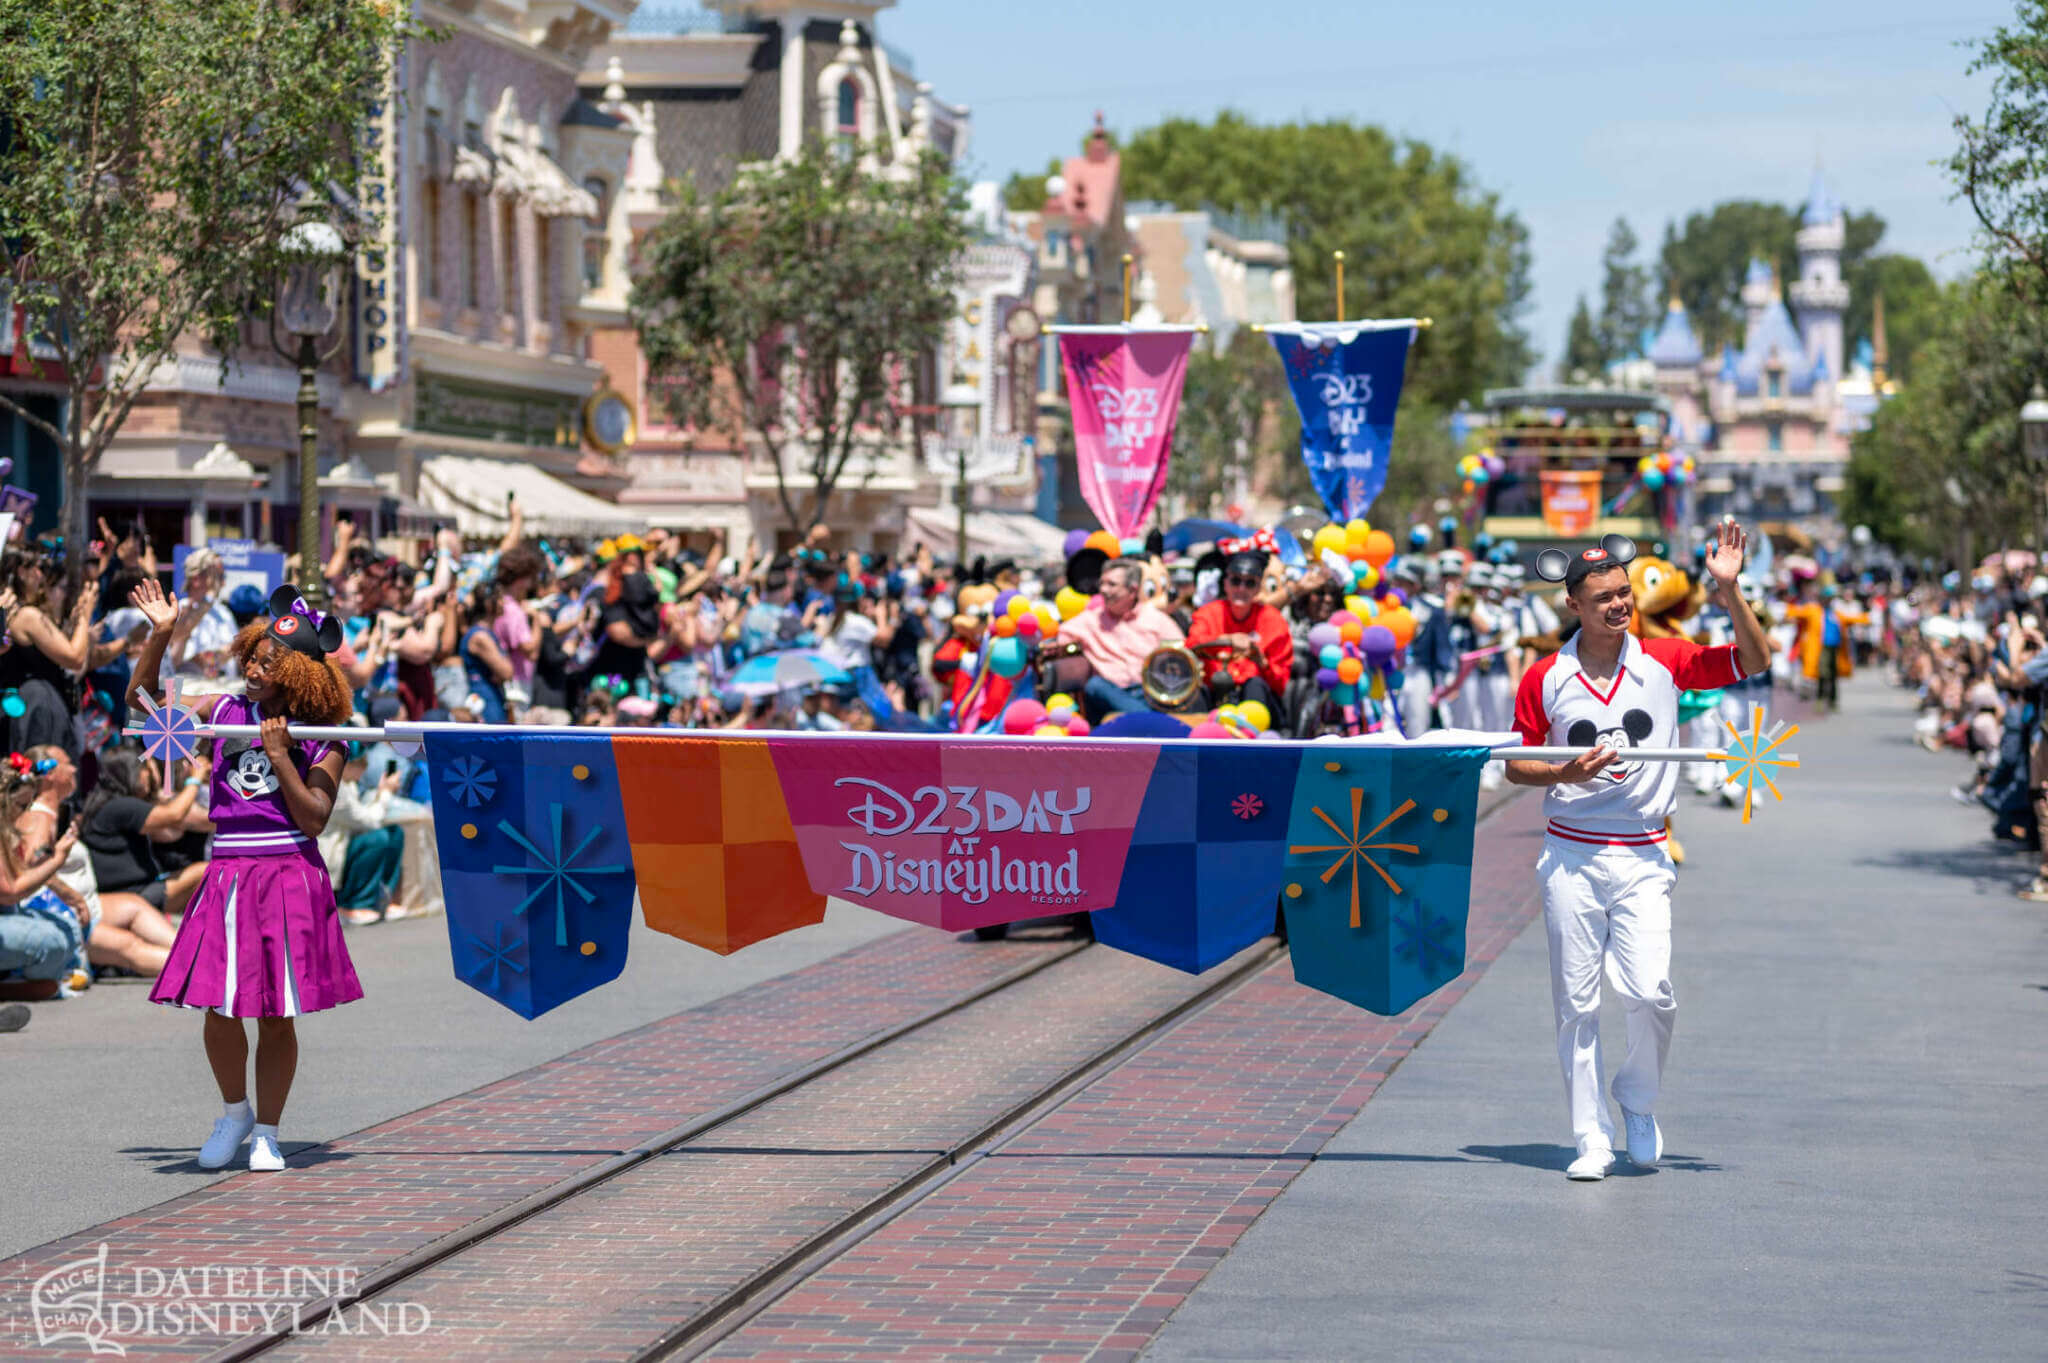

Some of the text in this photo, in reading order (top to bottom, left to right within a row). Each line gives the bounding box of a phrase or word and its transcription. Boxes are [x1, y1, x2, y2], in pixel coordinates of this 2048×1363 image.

[1092, 384, 1159, 418] D23
[1312, 374, 1372, 406] D23
[834, 777, 1091, 836] D23 DAY
[948, 837, 980, 856] AT
[840, 840, 1082, 904] Disneyland
[1031, 895, 1080, 905] RESORT
